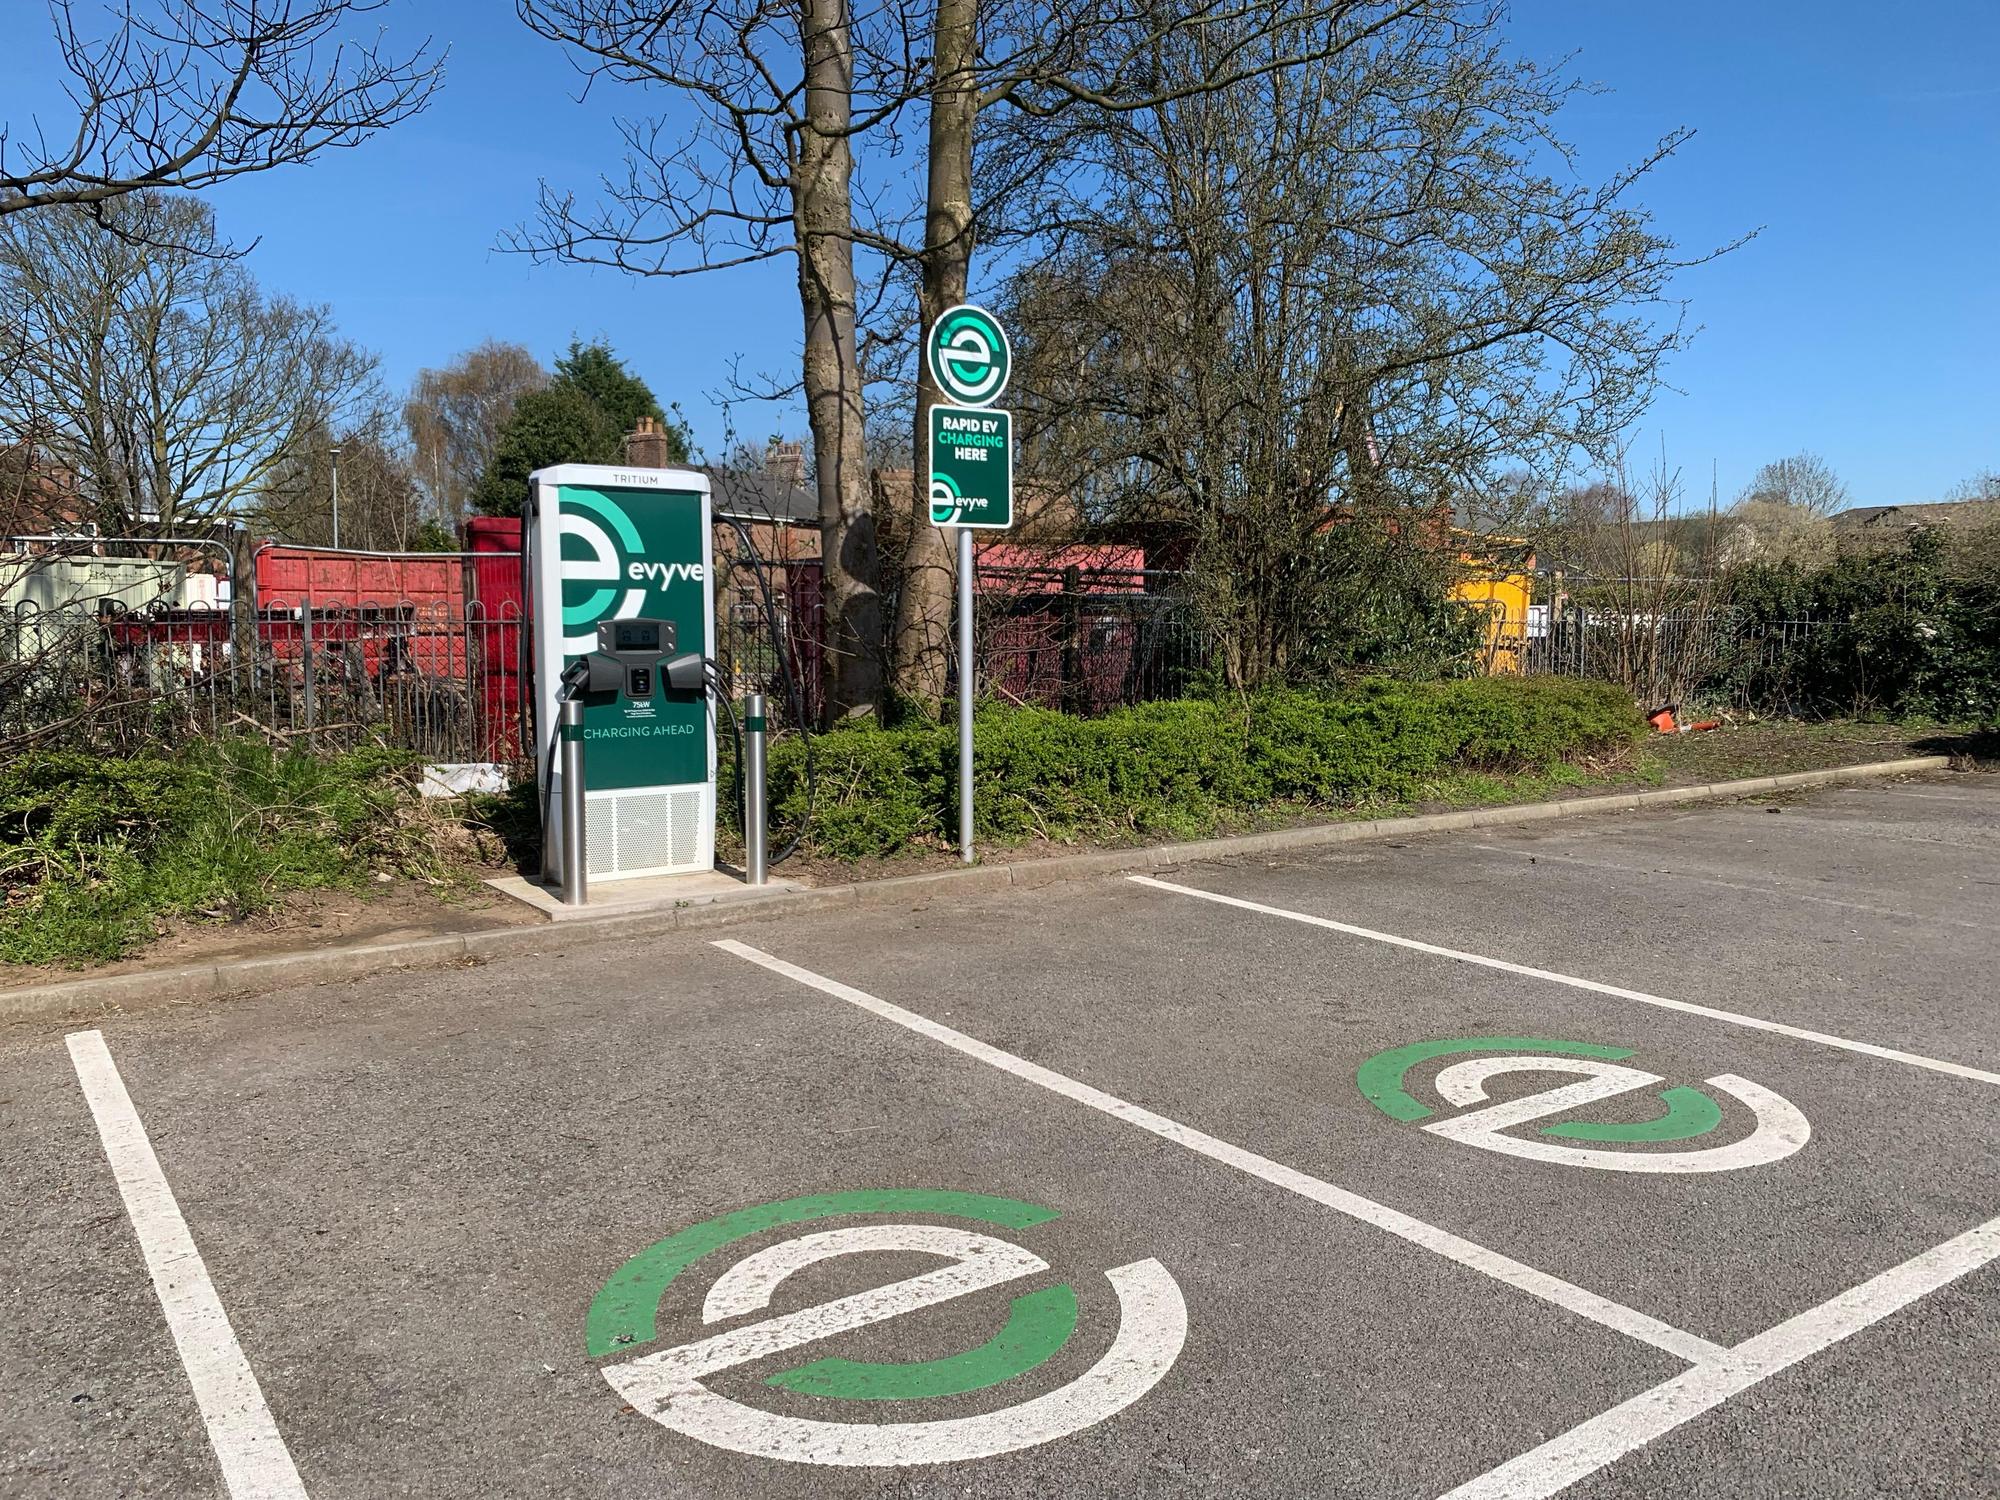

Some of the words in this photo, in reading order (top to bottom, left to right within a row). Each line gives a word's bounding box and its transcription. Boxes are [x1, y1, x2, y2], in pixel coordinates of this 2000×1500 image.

[943, 416, 981, 432] RAPID
[982, 419, 999, 434] EV
[938, 431, 1004, 448] CHARGING
[954, 446, 988, 461] HERE
[613, 474, 658, 485] TRITIUM
[955, 496, 989, 512] evyve
[628, 561, 704, 592] evyve
[583, 726, 650, 739] CHARGING
[653, 724, 695, 736] AHEAD
